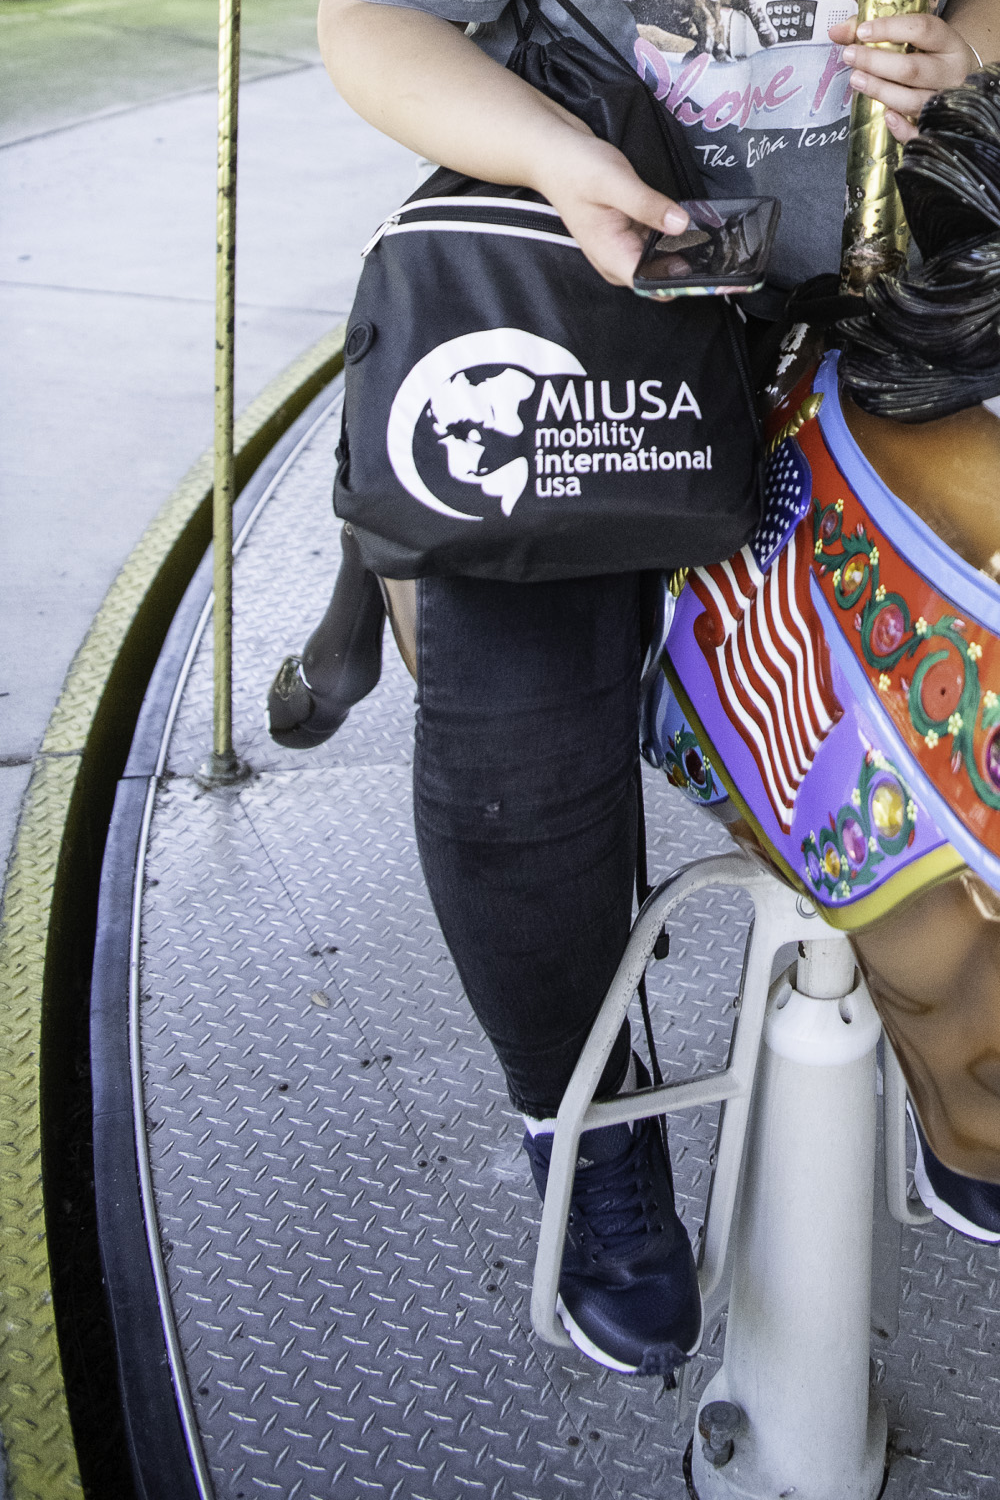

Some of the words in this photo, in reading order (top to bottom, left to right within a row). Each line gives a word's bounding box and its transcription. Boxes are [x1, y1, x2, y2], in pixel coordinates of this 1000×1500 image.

[695, 143, 739, 168] The
[746, 132, 790, 169] Extra
[791, 120, 850, 149] Terre
[536, 379, 702, 422] MIUSA
[535, 421, 645, 451] mobility
[535, 445, 712, 475] international
[535, 476, 581, 498] usa
